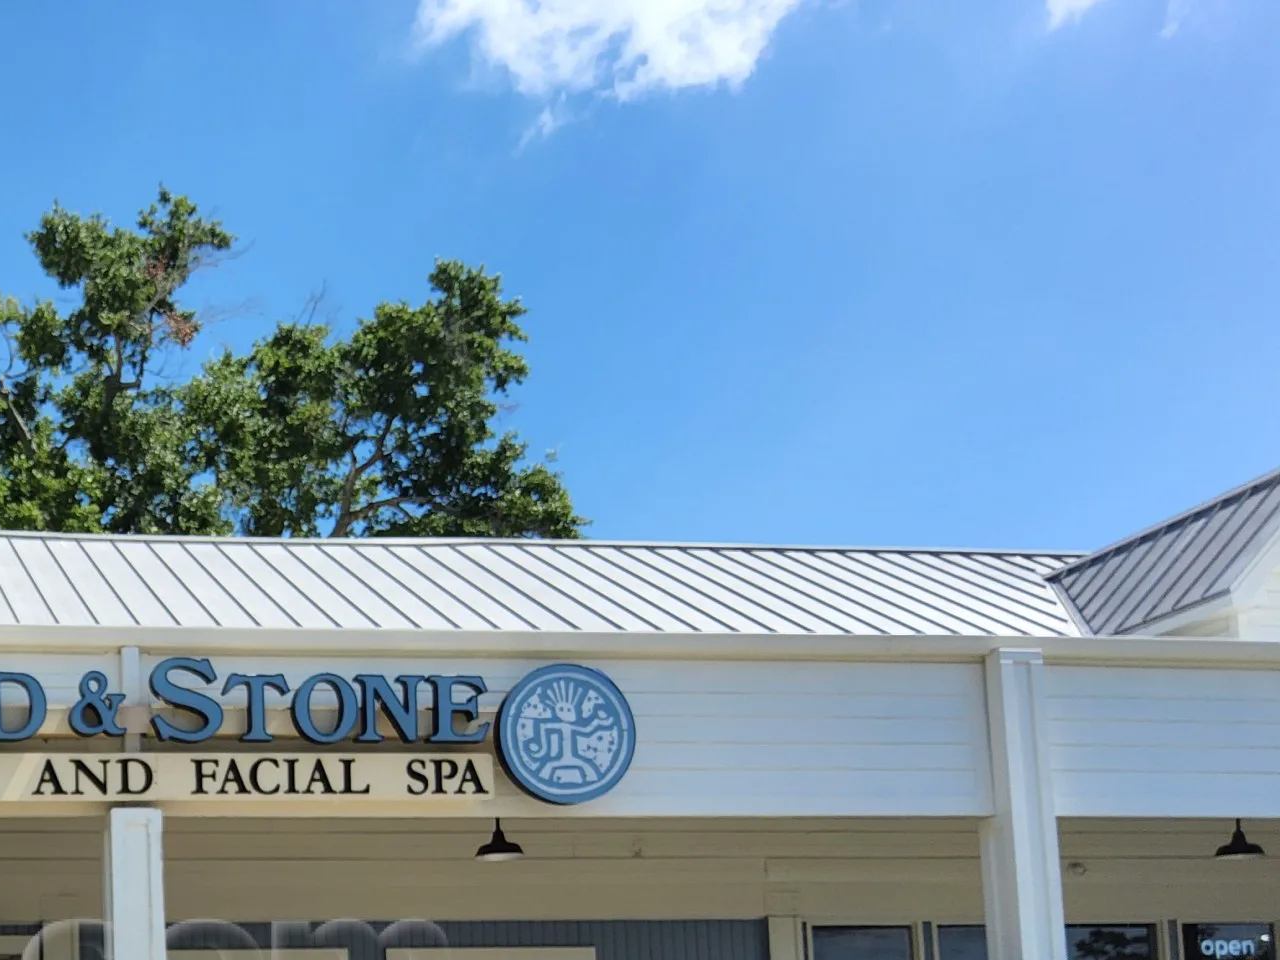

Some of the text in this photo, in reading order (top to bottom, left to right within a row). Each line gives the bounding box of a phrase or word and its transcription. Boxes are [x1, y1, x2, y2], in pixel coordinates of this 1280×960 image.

[68, 670, 126, 738] &
[148, 657, 490, 745] STONE
[31, 758, 153, 796] AND
[190, 757, 370, 795] FACIAL
[406, 758, 489, 796] SPA
[1200, 939, 1255, 960] open
